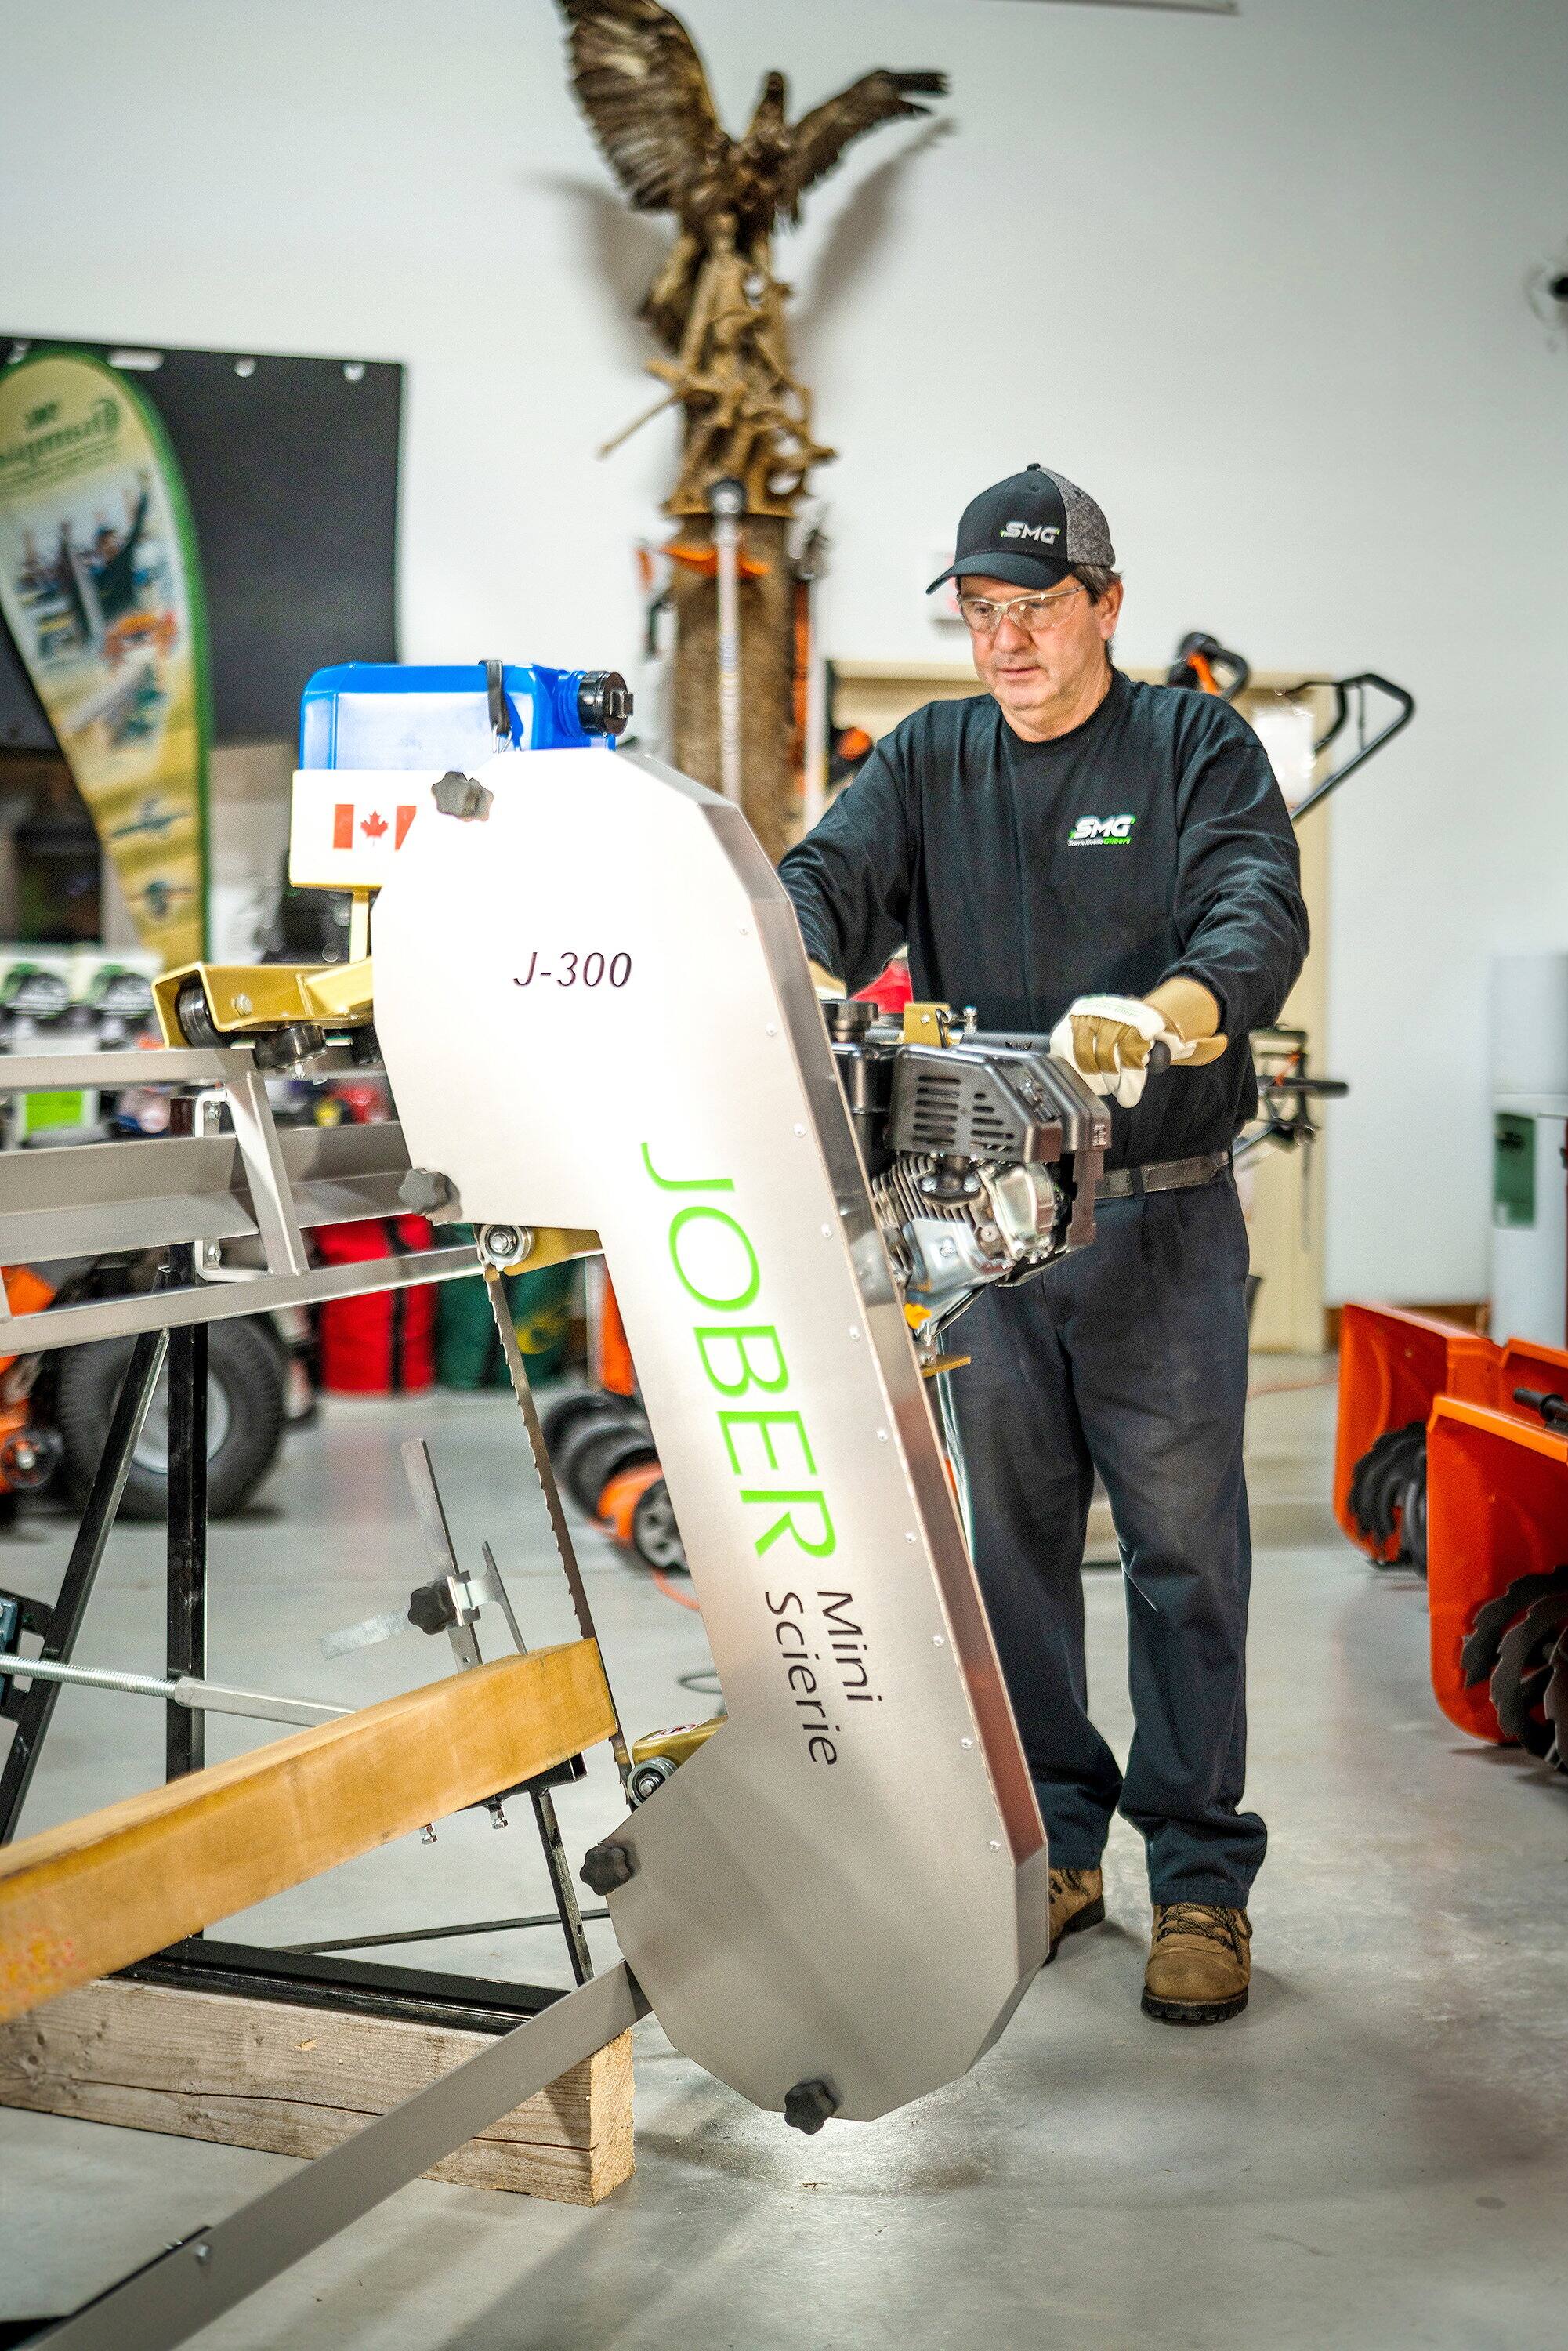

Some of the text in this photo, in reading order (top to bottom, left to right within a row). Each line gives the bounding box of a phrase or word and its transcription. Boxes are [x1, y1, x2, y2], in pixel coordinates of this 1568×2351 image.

[1001, 521, 1060, 545] SMG
[1070, 815, 1135, 839] SMG
[513, 951, 632, 987] J-300
[640, 1143, 836, 1559] JOBER
[765, 1591, 840, 1765] Scierie
[817, 1591, 882, 1701] Mini
